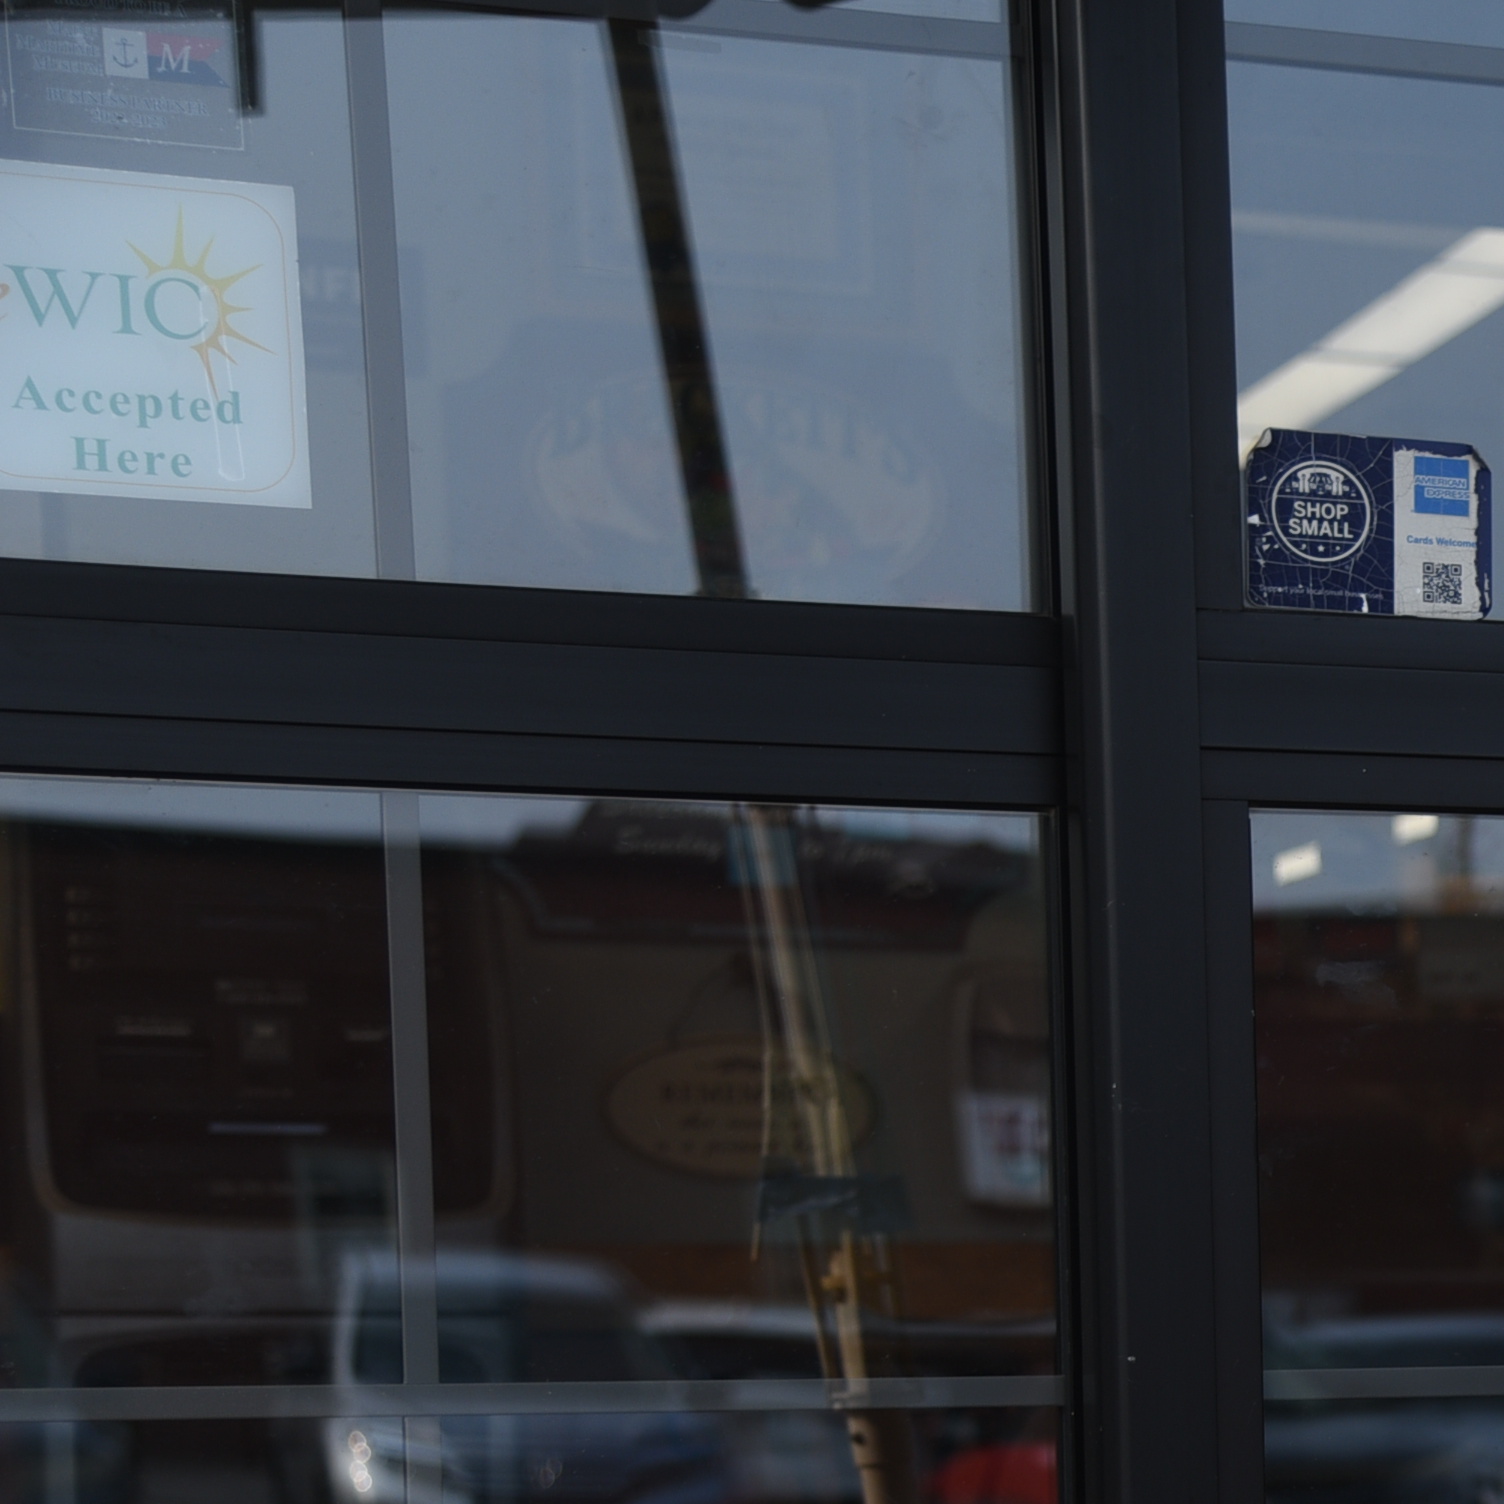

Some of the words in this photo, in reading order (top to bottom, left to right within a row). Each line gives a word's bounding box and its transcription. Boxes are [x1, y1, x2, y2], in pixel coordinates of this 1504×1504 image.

[157, 42, 192, 74] M
[11, 375, 243, 429] Accepted
[70, 435, 193, 478] Here
[1415, 476, 1466, 488] AMERICAN
[1426, 488, 1470, 499] EXPRESS
[1293, 501, 1349, 519] SHOP
[1288, 518, 1353, 539] SMALL
[1406, 534, 1434, 546] Cards
